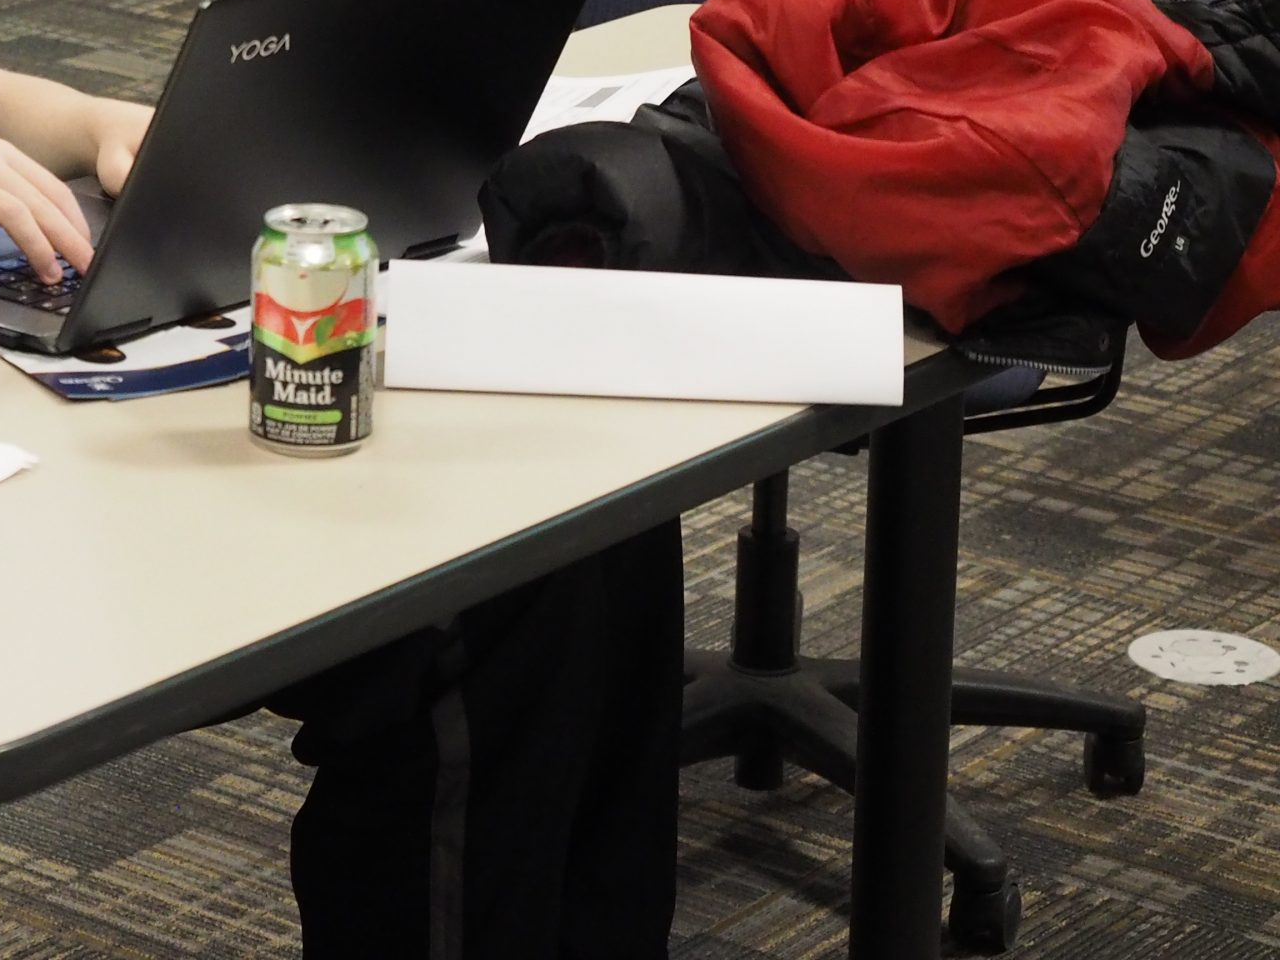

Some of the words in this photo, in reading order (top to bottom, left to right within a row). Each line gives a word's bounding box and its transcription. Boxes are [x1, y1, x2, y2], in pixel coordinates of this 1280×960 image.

[230, 33, 290, 64] YOGA
[1140, 185, 1178, 258] George
[265, 356, 344, 384] Minute
[273, 381, 333, 405] Maid
